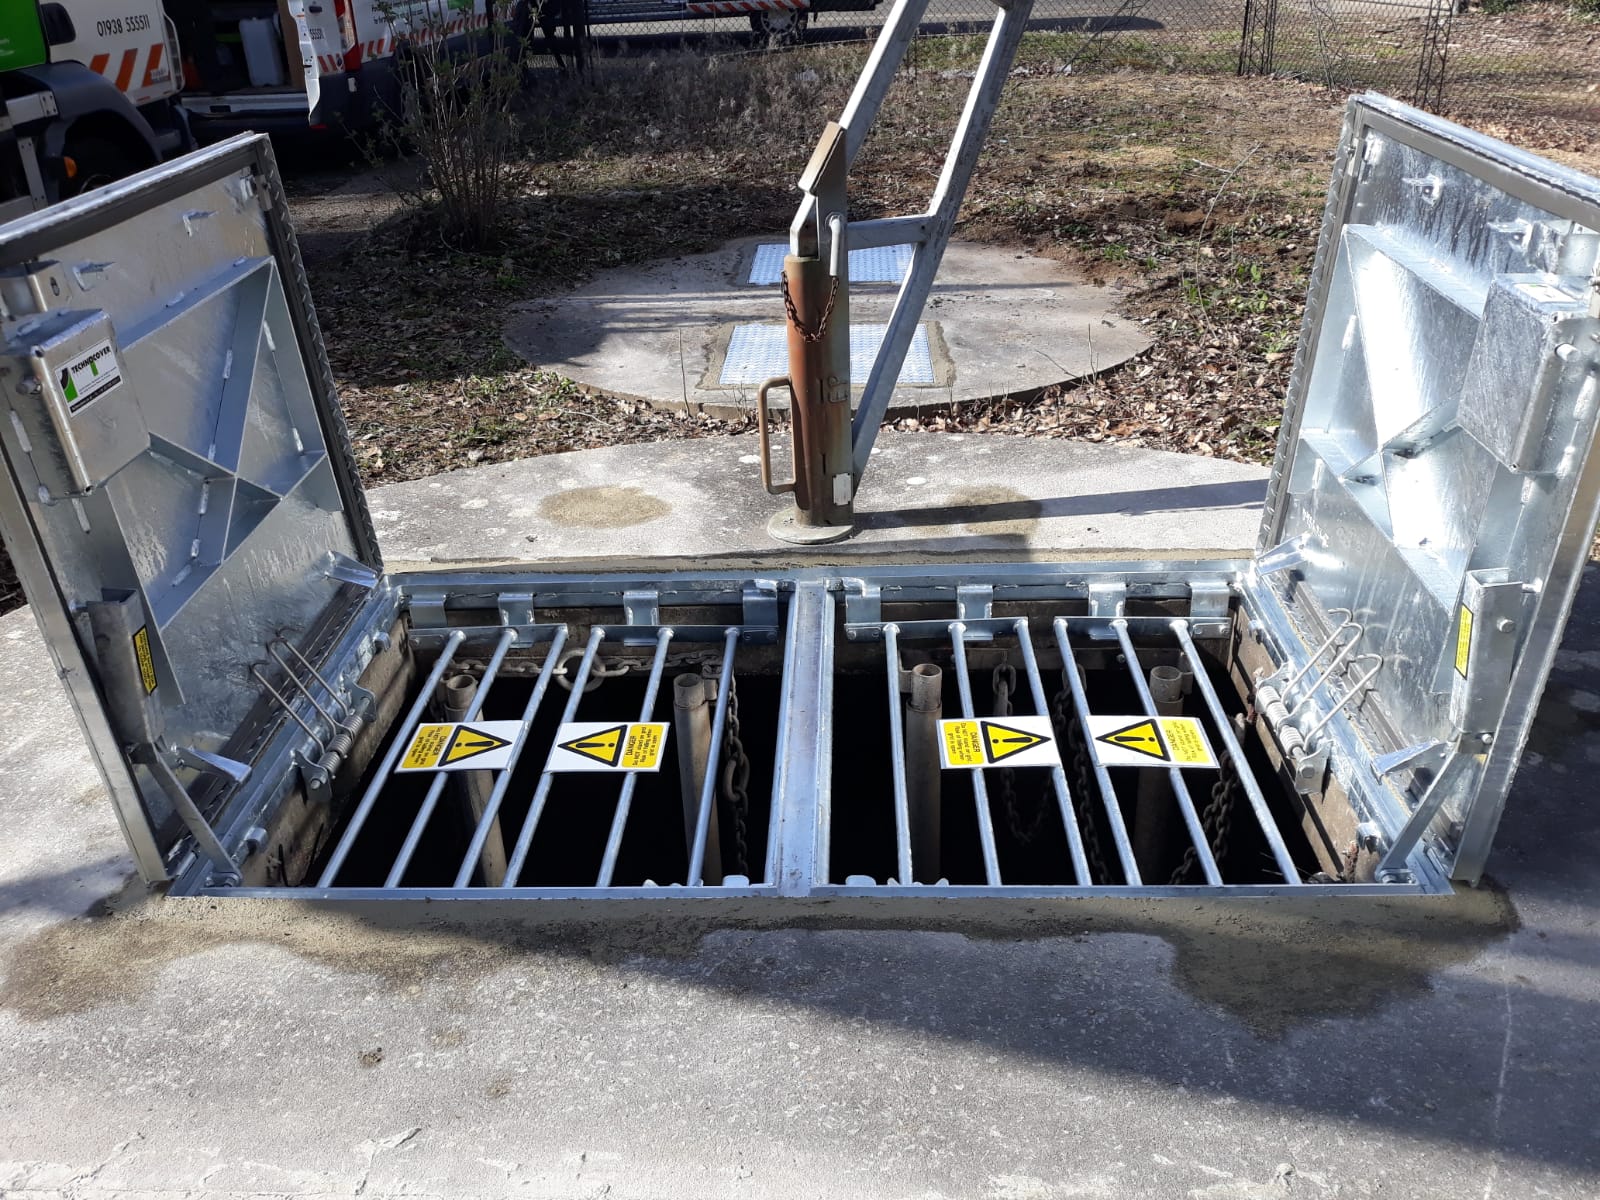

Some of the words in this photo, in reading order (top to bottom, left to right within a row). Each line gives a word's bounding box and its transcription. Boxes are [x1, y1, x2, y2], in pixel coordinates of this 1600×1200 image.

[97, 19, 123, 37] 01938
[125, 14, 150, 32] 555511
[71, 346, 111, 374] TECHNOCOVER
[432, 736, 447, 755] DANGER
[626, 736, 636, 755] DANGER
[970, 732, 980, 752] DANGER
